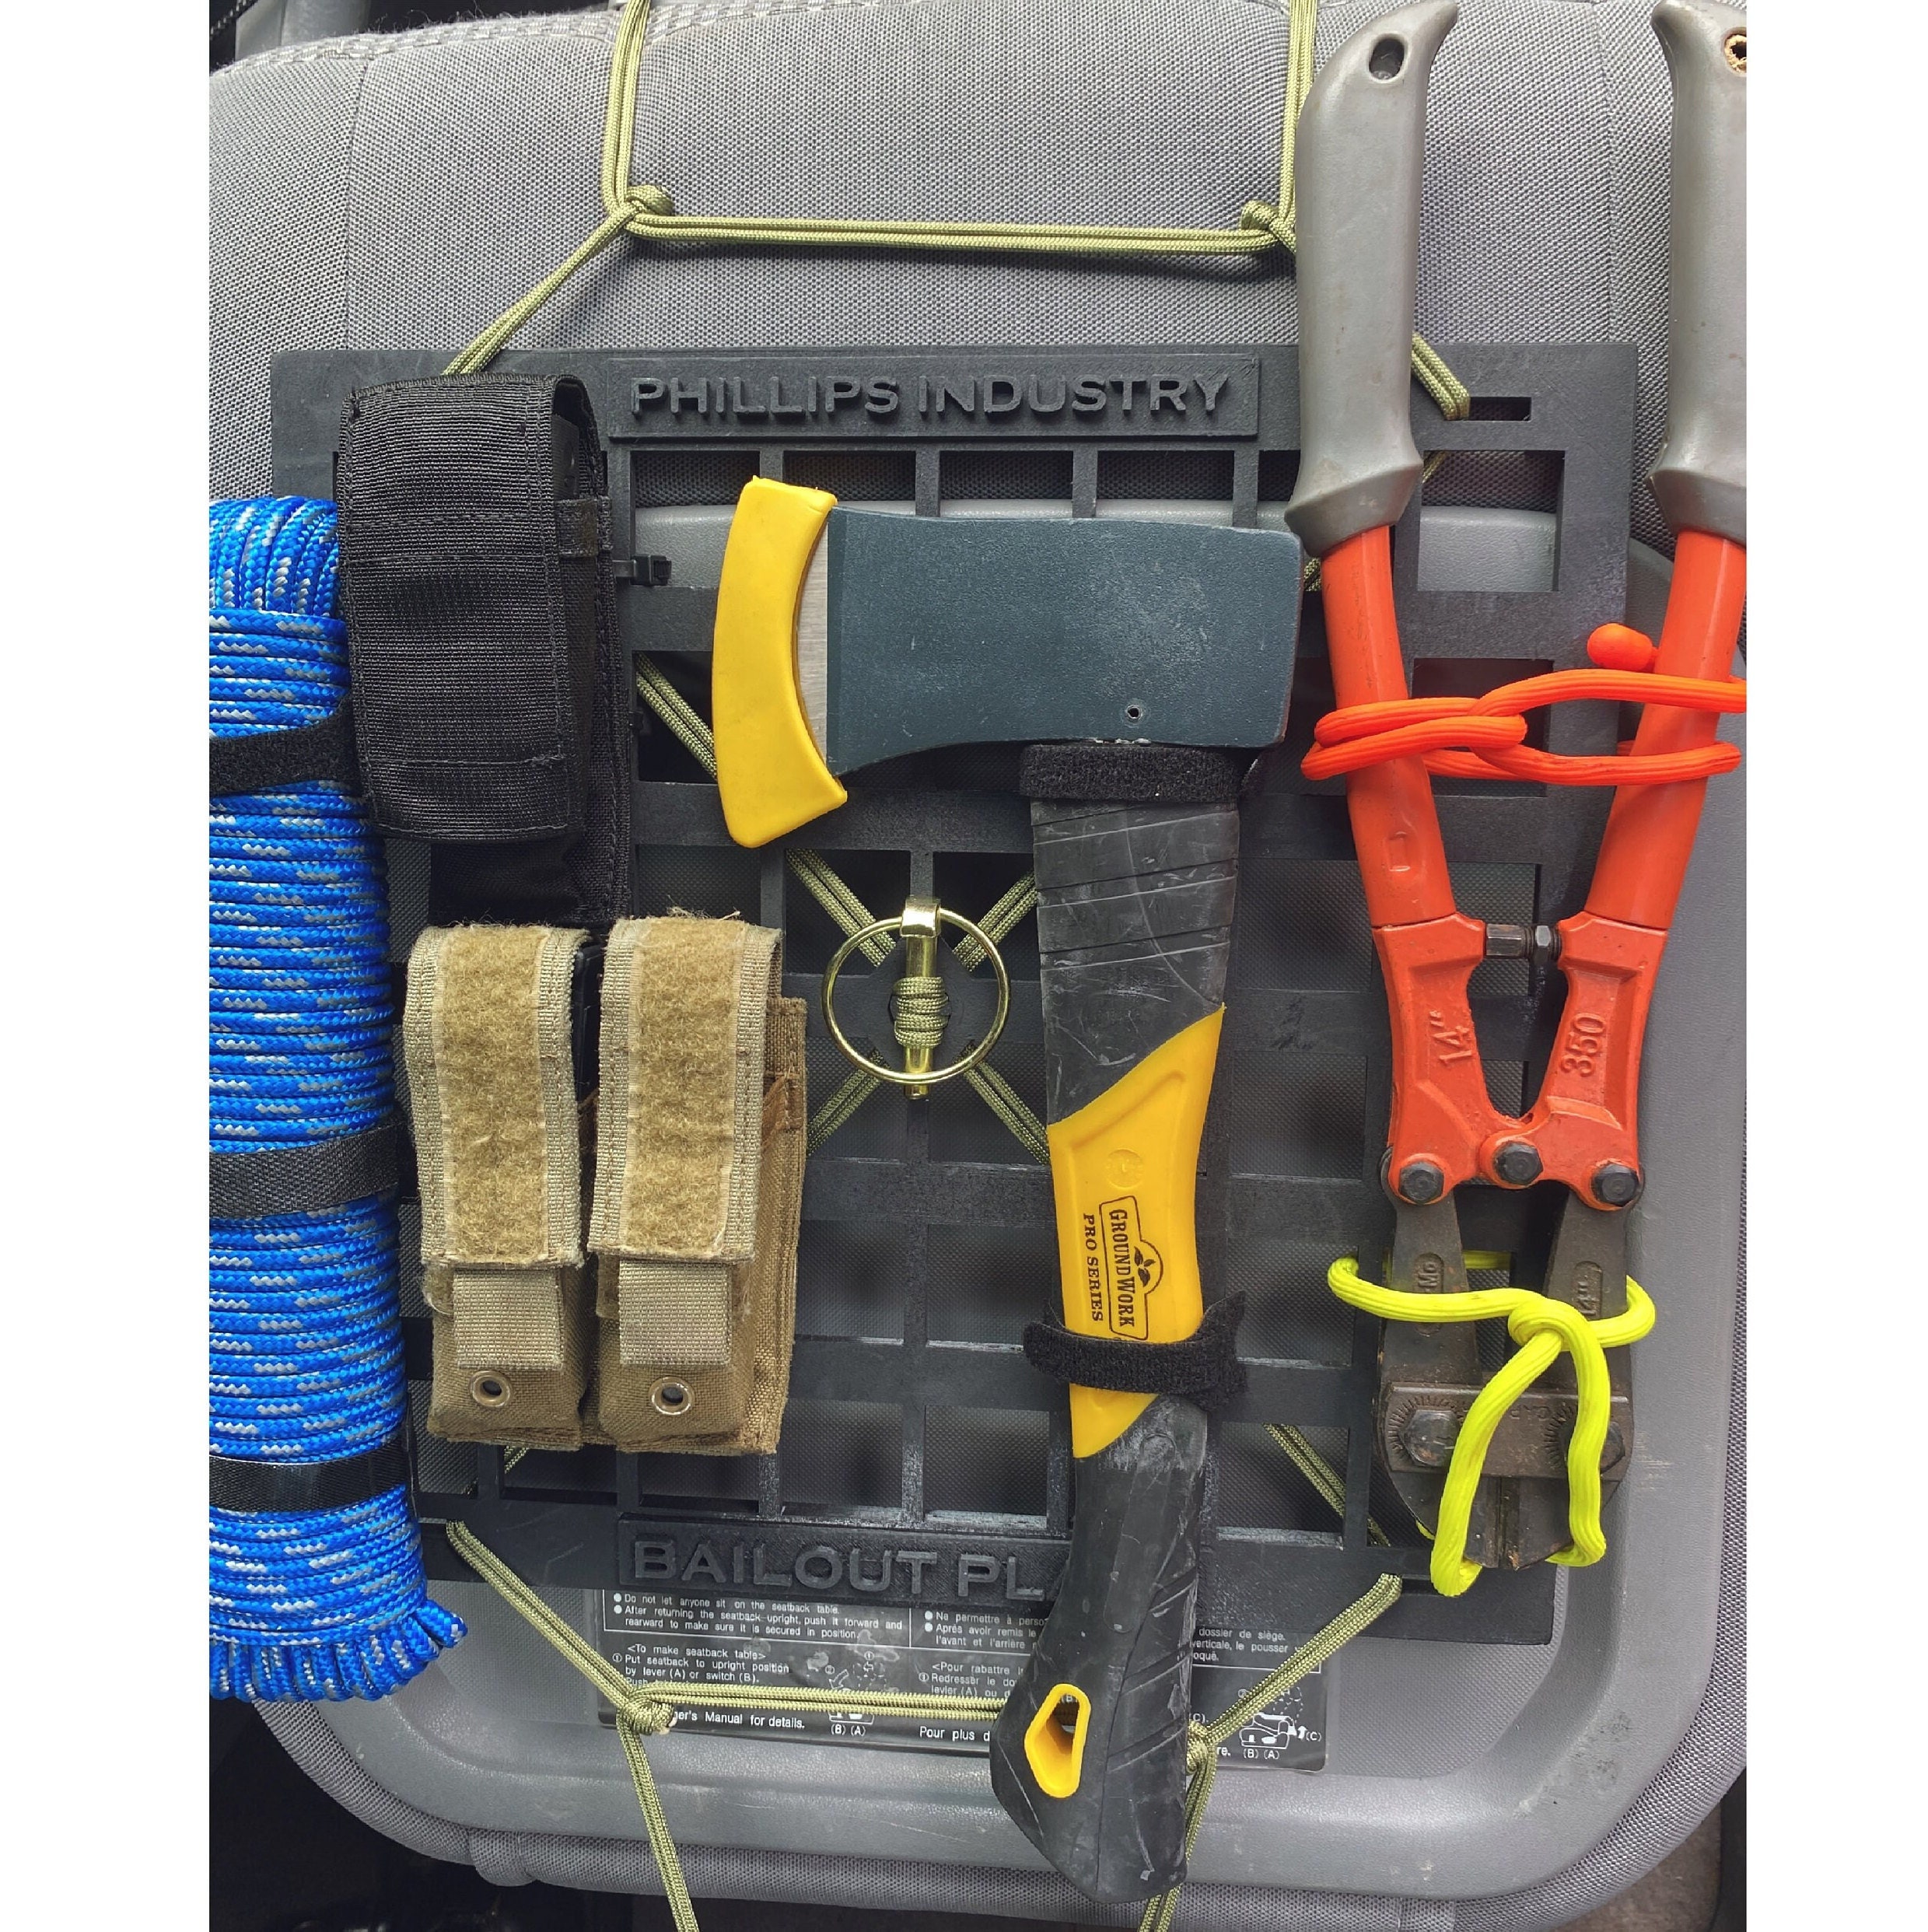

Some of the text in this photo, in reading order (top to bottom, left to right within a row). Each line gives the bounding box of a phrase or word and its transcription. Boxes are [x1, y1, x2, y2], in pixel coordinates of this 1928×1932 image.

[631, 373, 1230, 416] PHILLIPS INDUSTRY
[1560, 1012, 1608, 1078] 350
[1083, 1213, 1104, 1322] PRO SERIES
[1108, 1209, 1136, 1327] GROUNDWORK
[634, 1539, 1058, 1601] BAILOUT PL
[625, 1594, 840, 1615] Do not let anyone sit on the seatback table.
[625, 1605, 646, 1615] After
[655, 1608, 695, 1619] returning
[700, 1609, 715, 1619] the
[804, 1616, 827, 1626] push
[832, 1618, 838, 1626] it
[845, 1619, 880, 1629] forward
[885, 1621, 903, 1630] and
[936, 1612, 949, 1622] Ne
[955, 1613, 1001, 1625] permettre
[1198, 1626, 1233, 1638] dossier
[1239, 1629, 1252, 1639] de
[625, 1618, 859, 1640] rearward to make sure it is secured in position.
[936, 1635, 967, 1647] l'avant
[973, 1637, 982, 1647] et
[968, 1626, 992, 1636] avoir
[997, 1627, 1023, 1638] remis
[1028, 1629, 1037, 1638] le
[1235, 1640, 1244, 1650] le
[1251, 1643, 1289, 1654] pousser
[653, 1645, 679, 1655] make
[686, 1647, 729, 1658] seatback
[625, 1654, 641, 1664] Put
[646, 1657, 689, 1668] seatback
[696, 1658, 705, 1668] to
[712, 1661, 746, 1671] upright
[752, 1663, 789, 1673] position
[971, 1663, 1010, 1675] rabattre
[625, 1666, 636, 1676] by
[643, 1667, 666, 1677] lever
[670, 1668, 686, 1680] (A)
[689, 1671, 699, 1679] or
[706, 1671, 735, 1682] switch
[931, 1673, 979, 1685] Redresser
[987, 1676, 996, 1686] le
[1002, 1677, 1017, 1687] do
[985, 1689, 997, 1698] ou
[705, 1712, 743, 1724] Manual
[750, 1713, 766, 1726] for
[768, 1715, 806, 1729] details.
[831, 1724, 866, 1737] (B) (A)
[919, 1726, 946, 1739] Pour
[952, 1728, 975, 1742] plus
[1305, 1731, 1322, 1742] (C)
[1243, 1748, 1280, 1760] (B) (A)
